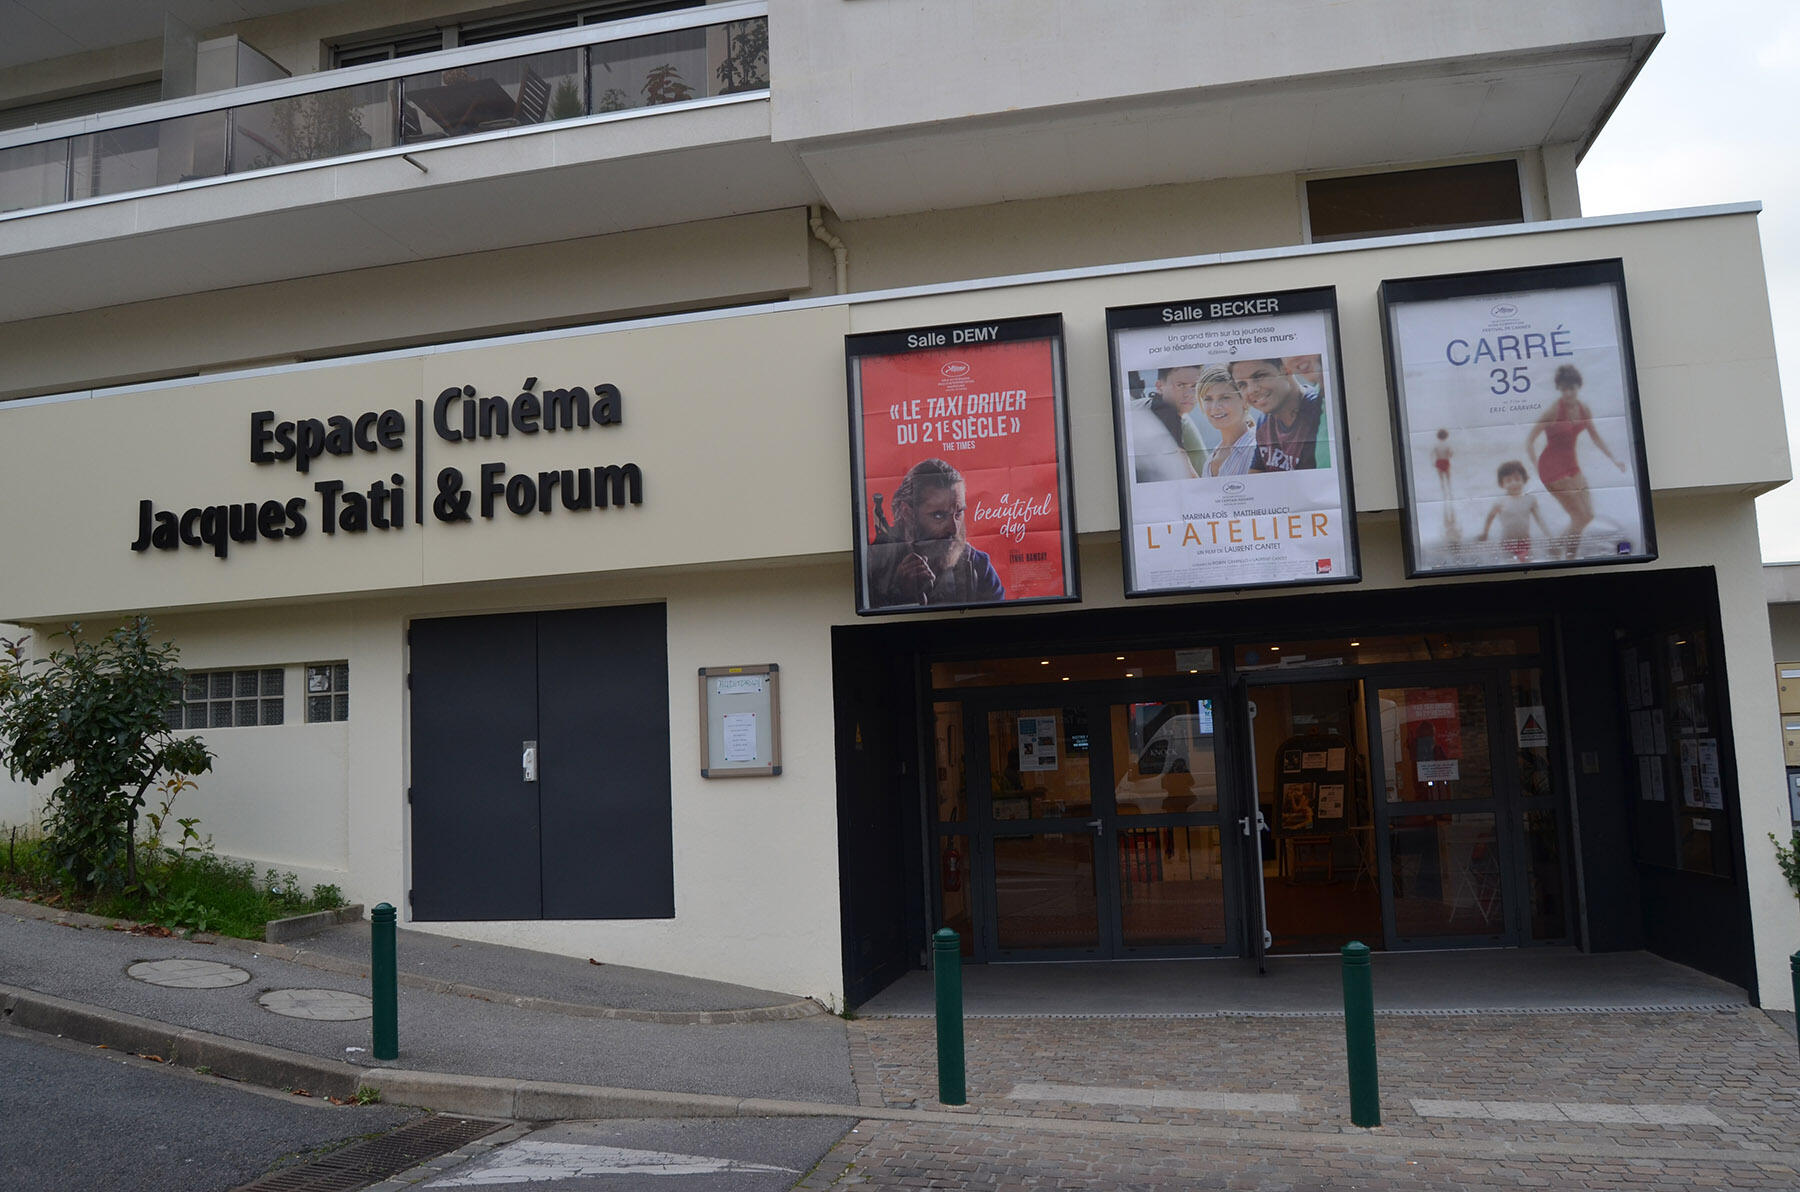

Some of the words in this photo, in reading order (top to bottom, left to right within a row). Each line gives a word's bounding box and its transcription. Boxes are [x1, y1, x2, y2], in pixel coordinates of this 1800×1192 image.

[1162, 306, 1203, 323] Salle
[1210, 298, 1279, 317] BECKER
[907, 332, 946, 349] Salle
[953, 326, 999, 344] DEMY
[1148, 346, 1163, 355] par
[1254, 334, 1268, 344] les
[1168, 334, 1179, 342] Un
[1179, 332, 1203, 344] grand
[1205, 329, 1218, 339] film
[1219, 330, 1231, 338] sur
[1241, 326, 1275, 338] jeunesse
[1446, 324, 1573, 367] CARRÉ
[1490, 366, 1531, 395] 35
[433, 376, 622, 442] Cinéma
[927, 395, 962, 418] TAXI
[967, 390, 1027, 414] DRIVER
[250, 407, 405, 472] Espace
[897, 424, 918, 445] DU
[943, 442, 955, 452] THE
[956, 440, 976, 450] TIMES
[433, 467, 472, 523] &
[481, 462, 643, 518] Forum
[1000, 493, 1009, 504] a
[131, 496, 307, 559] Jacques
[315, 473, 404, 533] Tati
[974, 493, 1052, 522] beautiful
[1182, 511, 1211, 522] MARINA
[1233, 507, 1267, 518] MATTHIEU
[1268, 506, 1290, 516] LUCCI
[1000, 516, 1026, 543] day
[1147, 513, 1329, 549] L'ATELIER
[1224, 543, 1253, 554] LAURENT
[1254, 542, 1281, 551] CANTET
